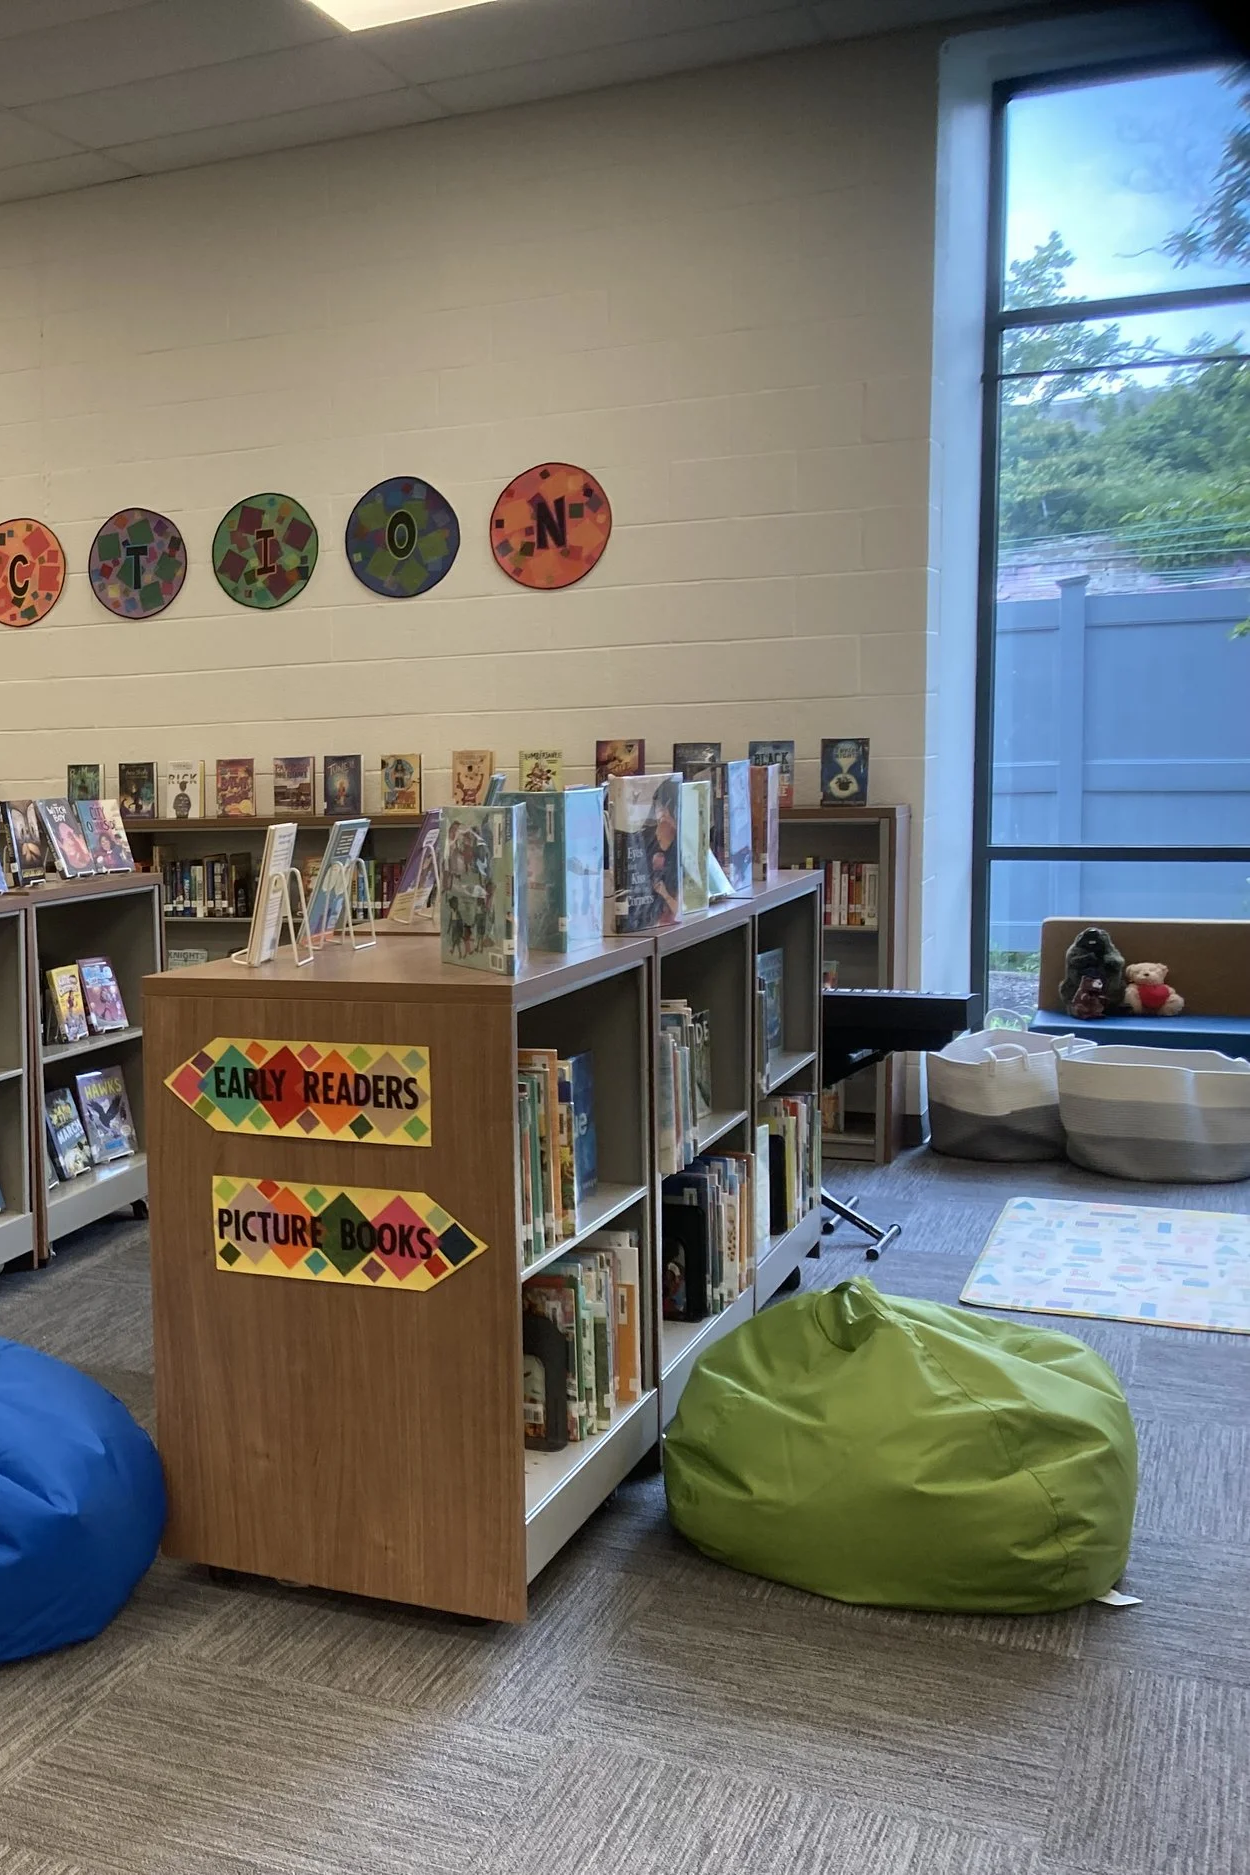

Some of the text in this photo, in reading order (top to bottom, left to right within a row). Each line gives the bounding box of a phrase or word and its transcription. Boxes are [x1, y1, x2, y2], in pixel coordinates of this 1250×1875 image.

[84, 1079, 122, 1100] HAWKS
[214, 1066, 419, 1110] EARLY READERS
[57, 1118, 84, 1145] MARCH
[218, 1207, 434, 1261] PICTURE BOOKS
